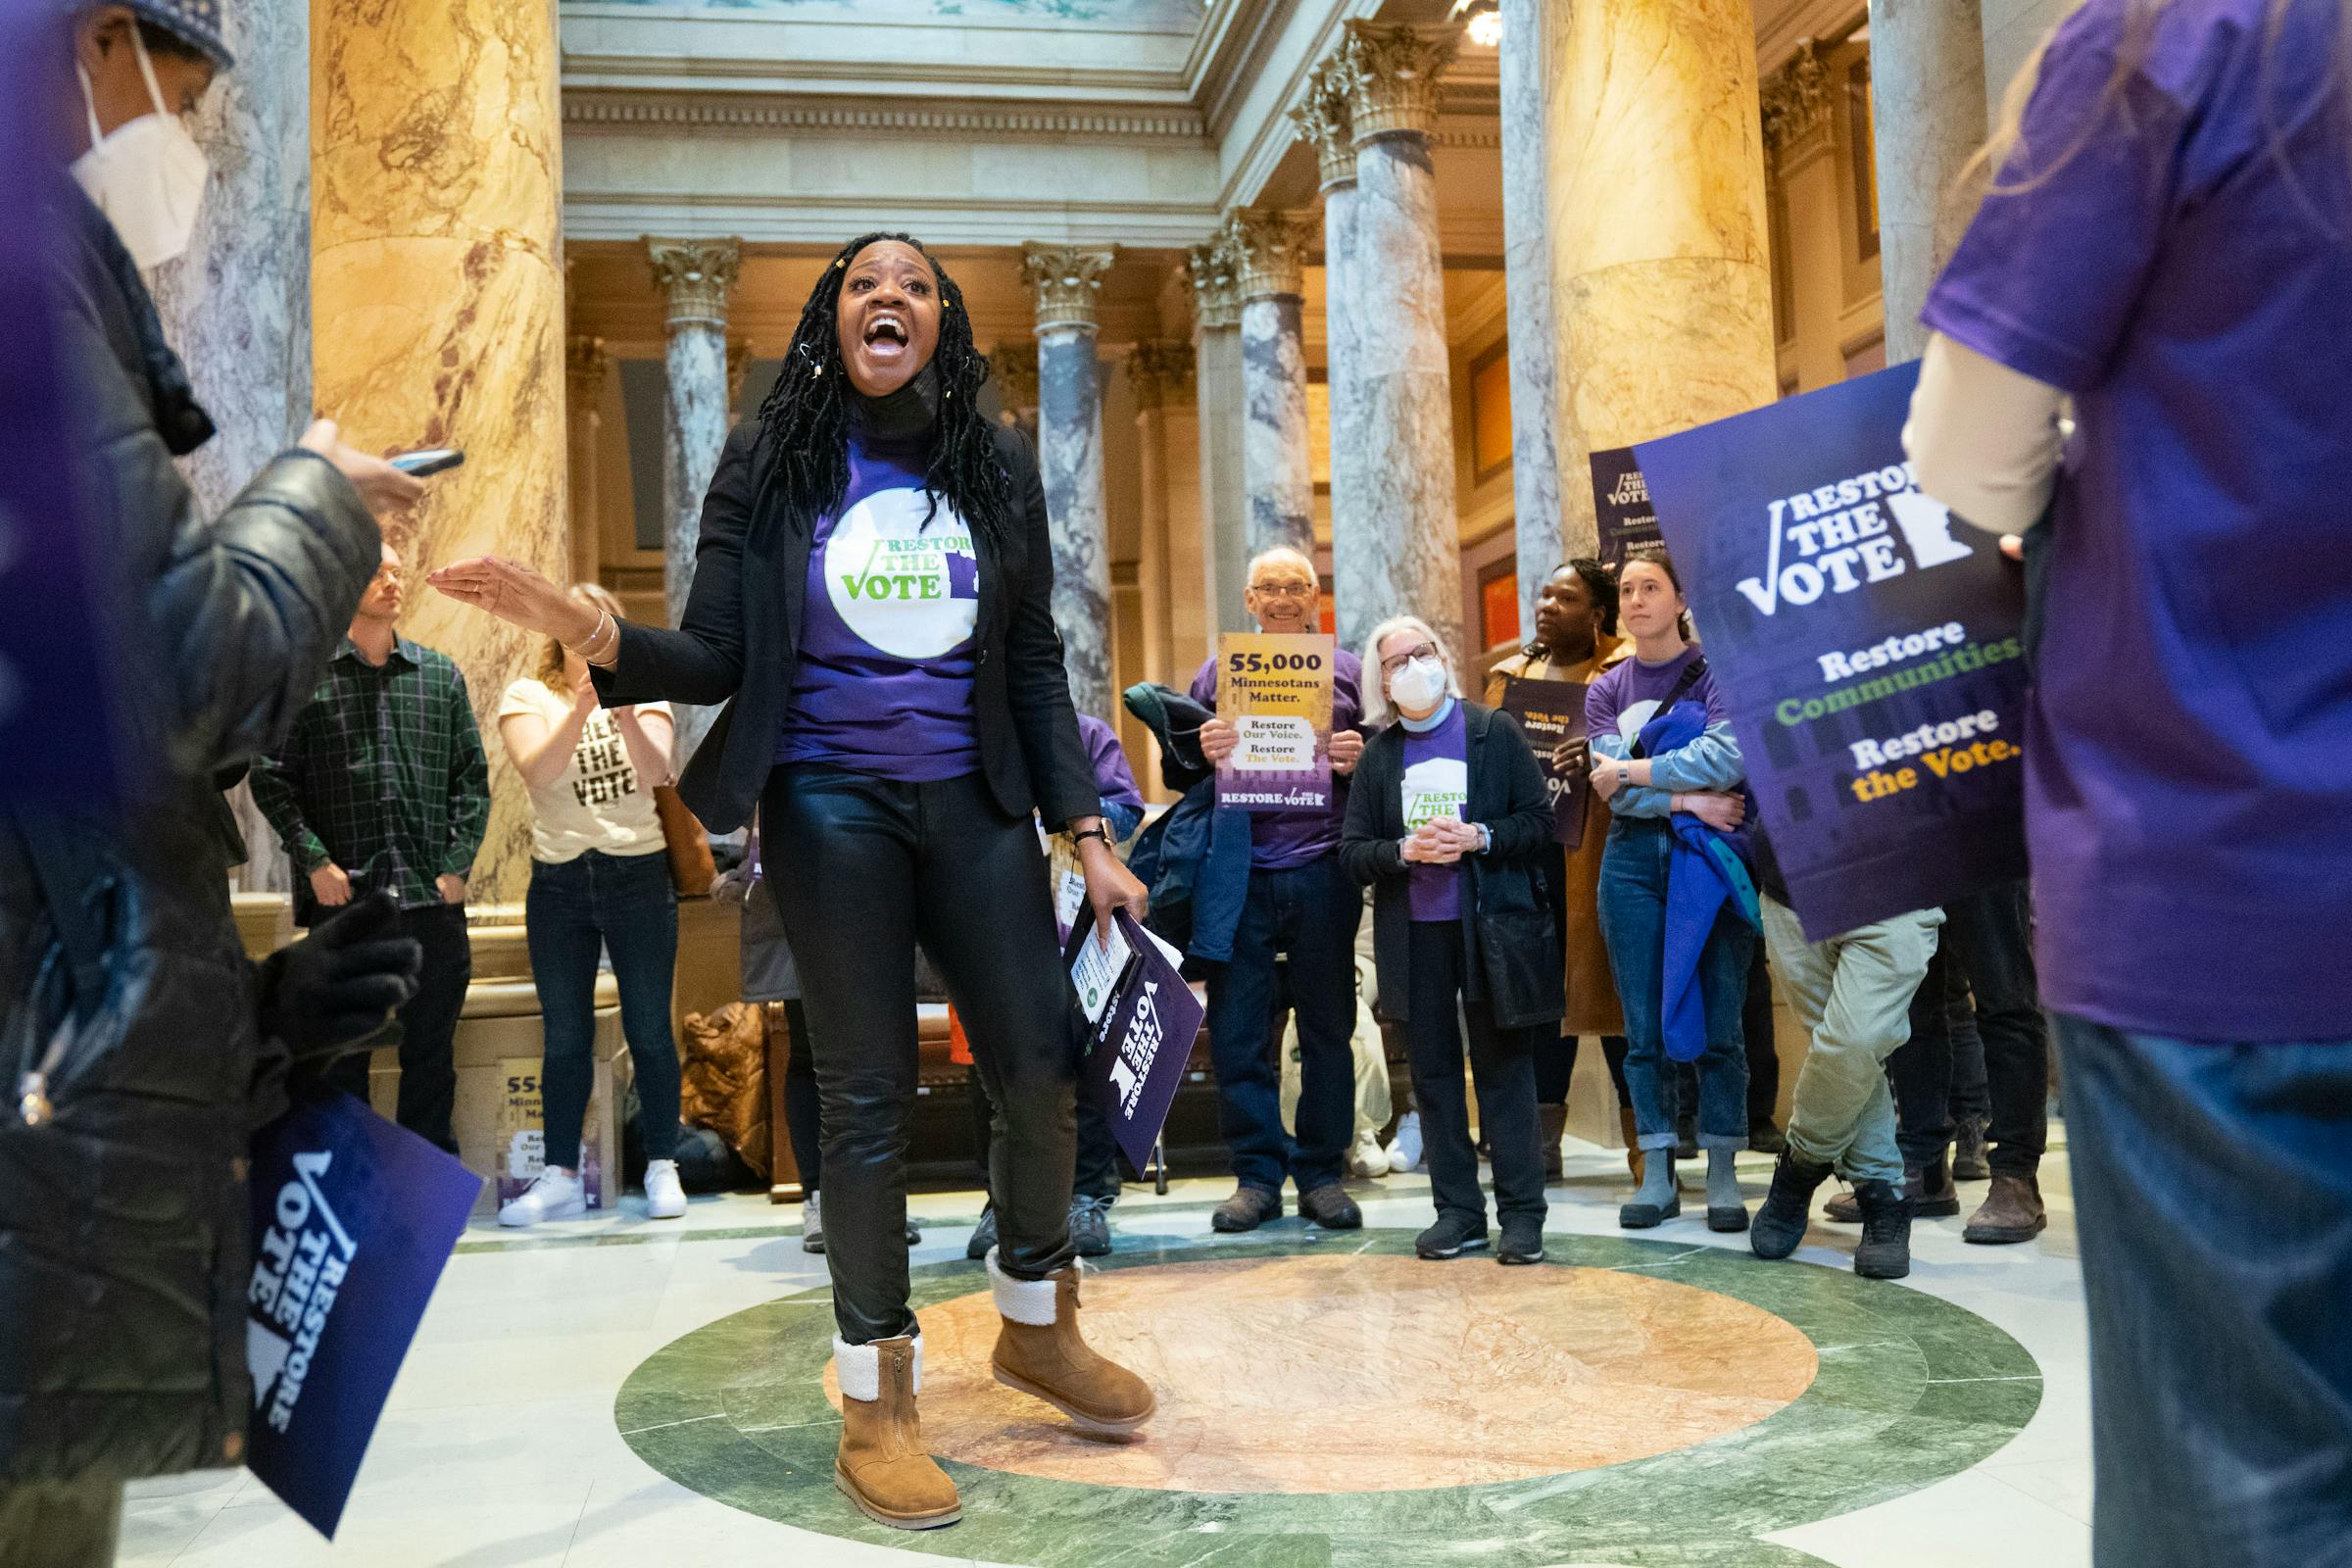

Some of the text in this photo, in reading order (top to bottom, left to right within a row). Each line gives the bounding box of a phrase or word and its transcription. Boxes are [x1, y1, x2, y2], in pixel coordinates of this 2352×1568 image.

[1789, 462, 1918, 520] RESTO
[888, 536, 972, 552] RESTOR
[1787, 502, 1888, 557] THE
[840, 539, 942, 600] VOTE
[880, 554, 941, 571] THE
[1736, 500, 1906, 616] VOTE
[1229, 654, 1322, 674] 55,000
[1817, 620, 1966, 683] Restore
[1231, 676, 1319, 688] Minnesotans
[1250, 692, 1300, 703] Matter.
[1775, 635, 2023, 727] Communities
[1244, 730, 1303, 739] Our Voice.
[1250, 720, 1296, 730] Restore
[1525, 720, 1566, 734] Restore
[1850, 709, 2000, 770] Restore
[575, 738, 624, 774] THE
[1246, 754, 1300, 763] The Vote.
[1250, 745, 1296, 754] Restore
[572, 767, 636, 807] VOTE
[1850, 739, 2022, 803] the Vote.
[1221, 793, 1284, 804] RESTORE
[1284, 787, 1315, 806] VOTE
[1418, 804, 1455, 816] THE
[1423, 792, 1468, 803] RESTO
[1122, 981, 1163, 1061] VOTE
[1132, 1021, 1155, 1068] THE
[1124, 1037, 1163, 1120] RESTORE
[248, 1151, 358, 1315] VOTE
[274, 1229, 331, 1334] THE
[268, 1251, 351, 1435] RESTORE
